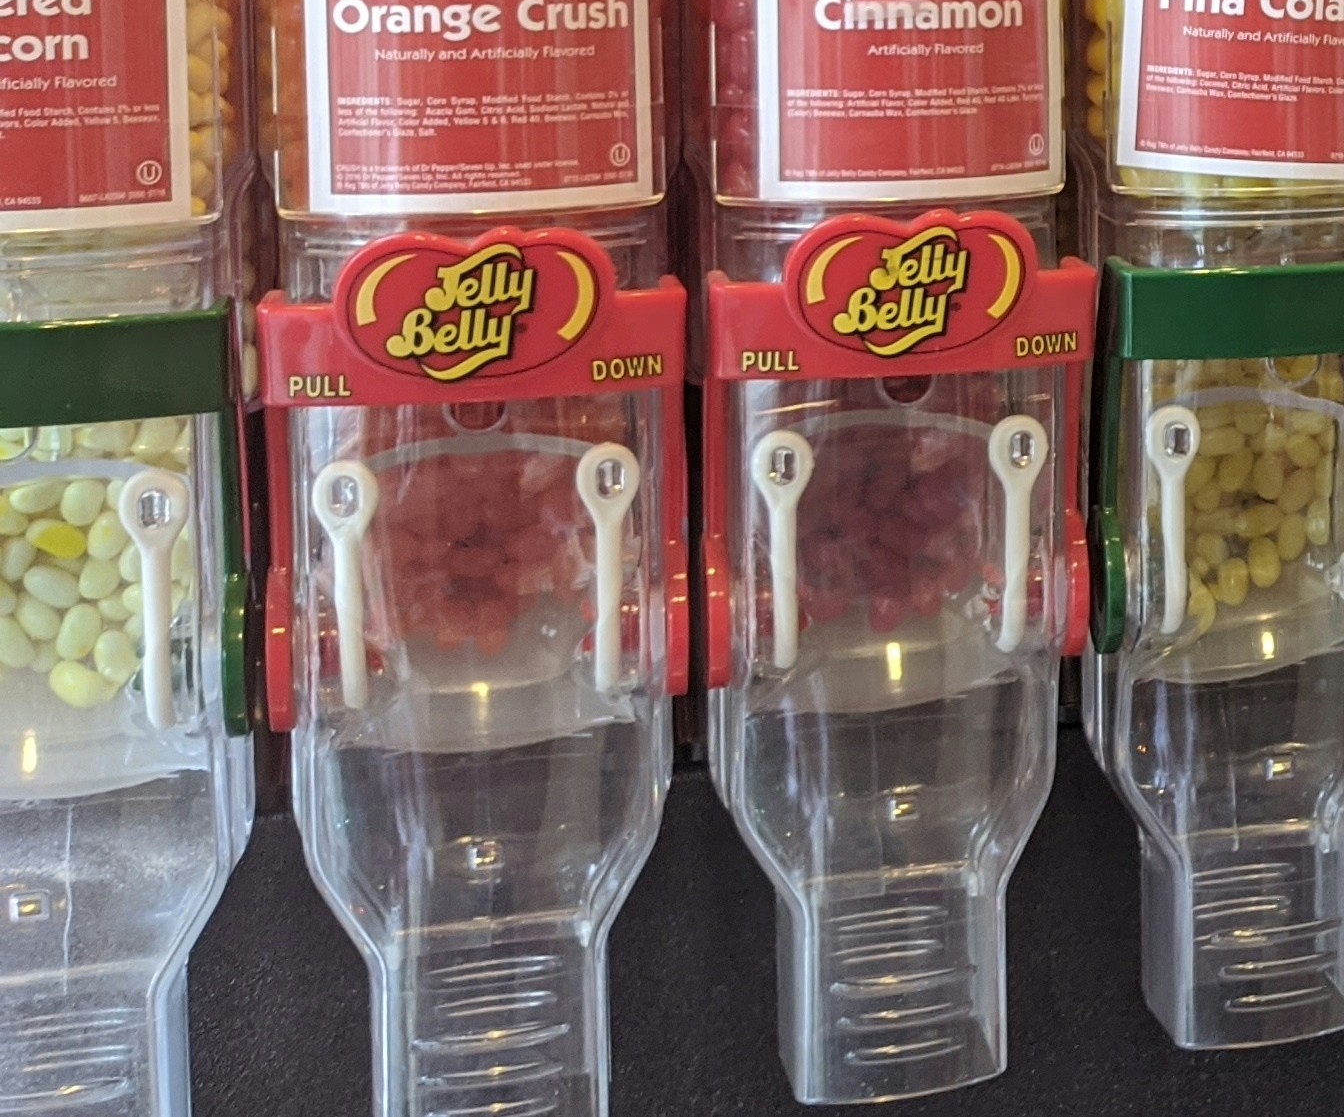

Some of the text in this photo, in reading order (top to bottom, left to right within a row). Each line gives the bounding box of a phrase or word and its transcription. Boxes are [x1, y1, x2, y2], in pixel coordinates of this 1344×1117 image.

[374, 45, 595, 62] Naturally and Artificially Flavored
[868, 42, 984, 57] Artificially Flavored
[1183, 25, 1235, 40] Naturally
[1237, 31, 1261, 42] and
[1263, 31, 1321, 46] Artificially
[54, 75, 118, 89] Flavored
[425, 244, 533, 313] Jelly
[870, 226, 968, 292] Jelly
[833, 286, 947, 356] Belly
[386, 306, 513, 381] Belly
[742, 332, 1077, 372] PULL DOWN
[289, 355, 662, 398] PULL DOWN
